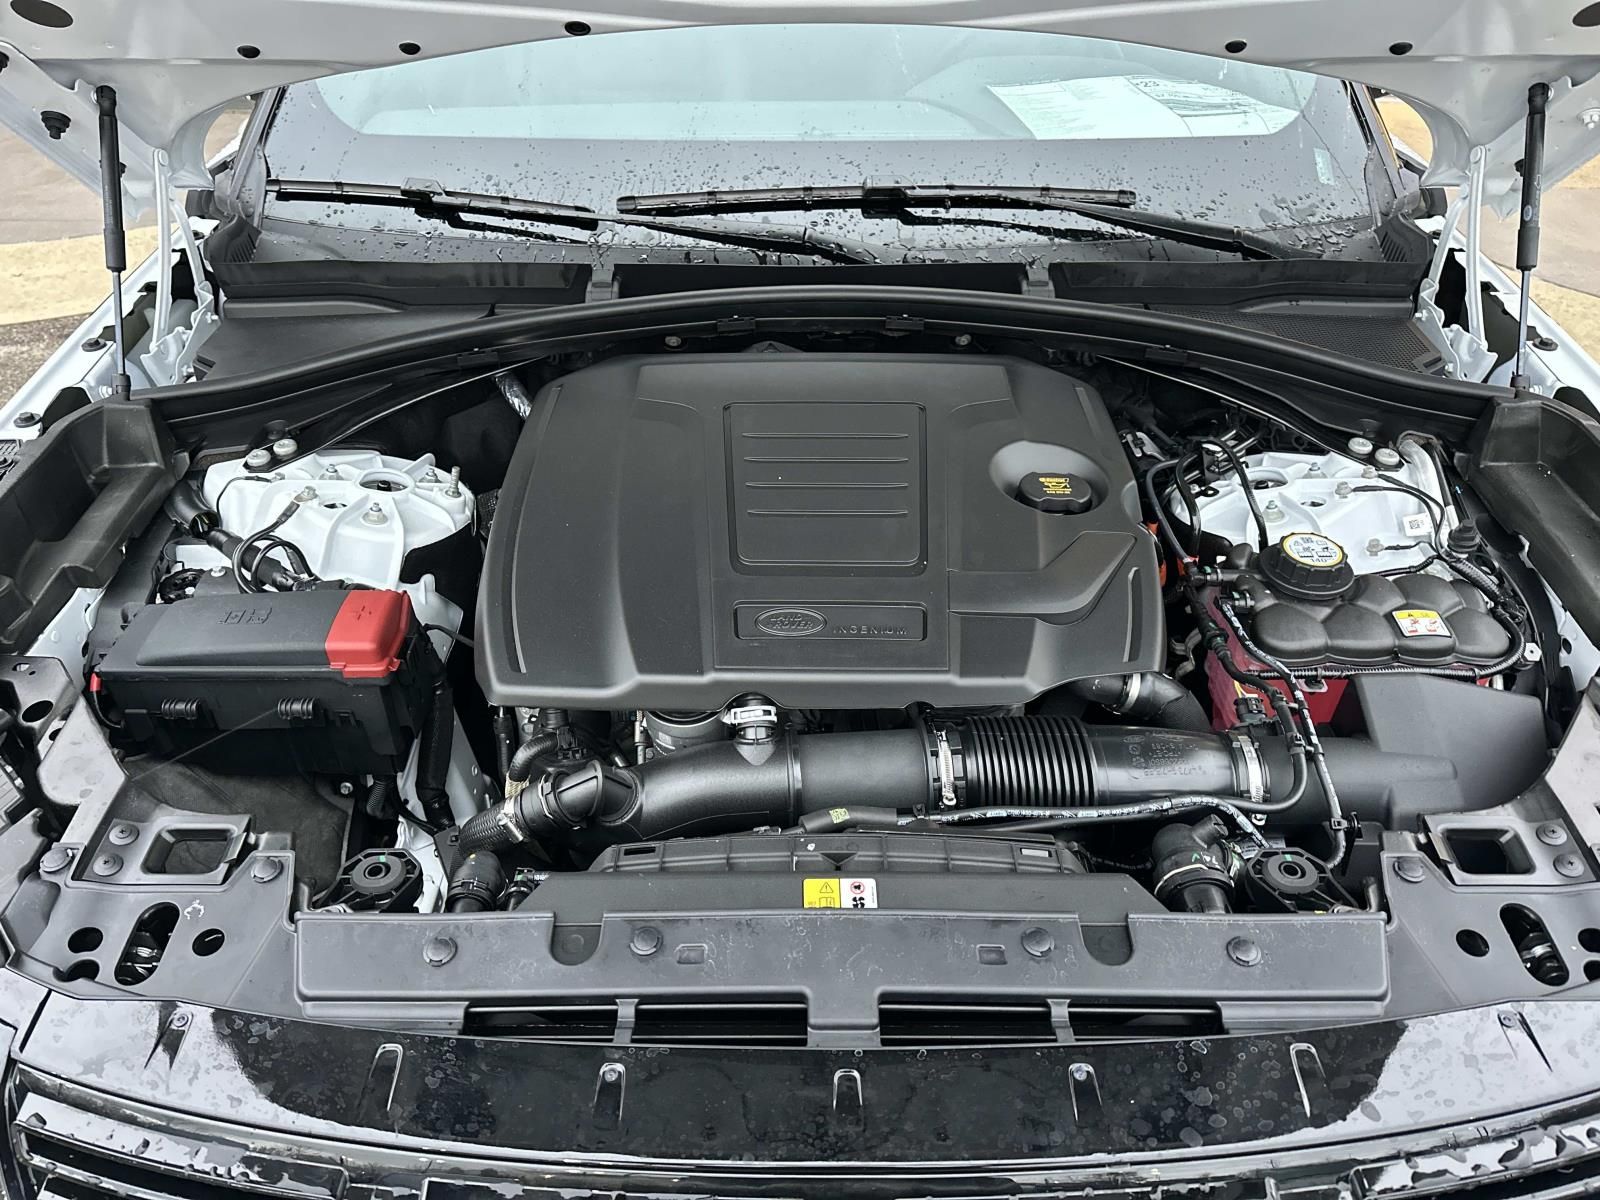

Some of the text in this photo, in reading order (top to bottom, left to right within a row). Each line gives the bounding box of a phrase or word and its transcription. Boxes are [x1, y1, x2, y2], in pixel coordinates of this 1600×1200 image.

[770, 613, 803, 622] LAND
[771, 621, 814, 630] ROVER
[832, 624, 908, 636] INGENIUM
